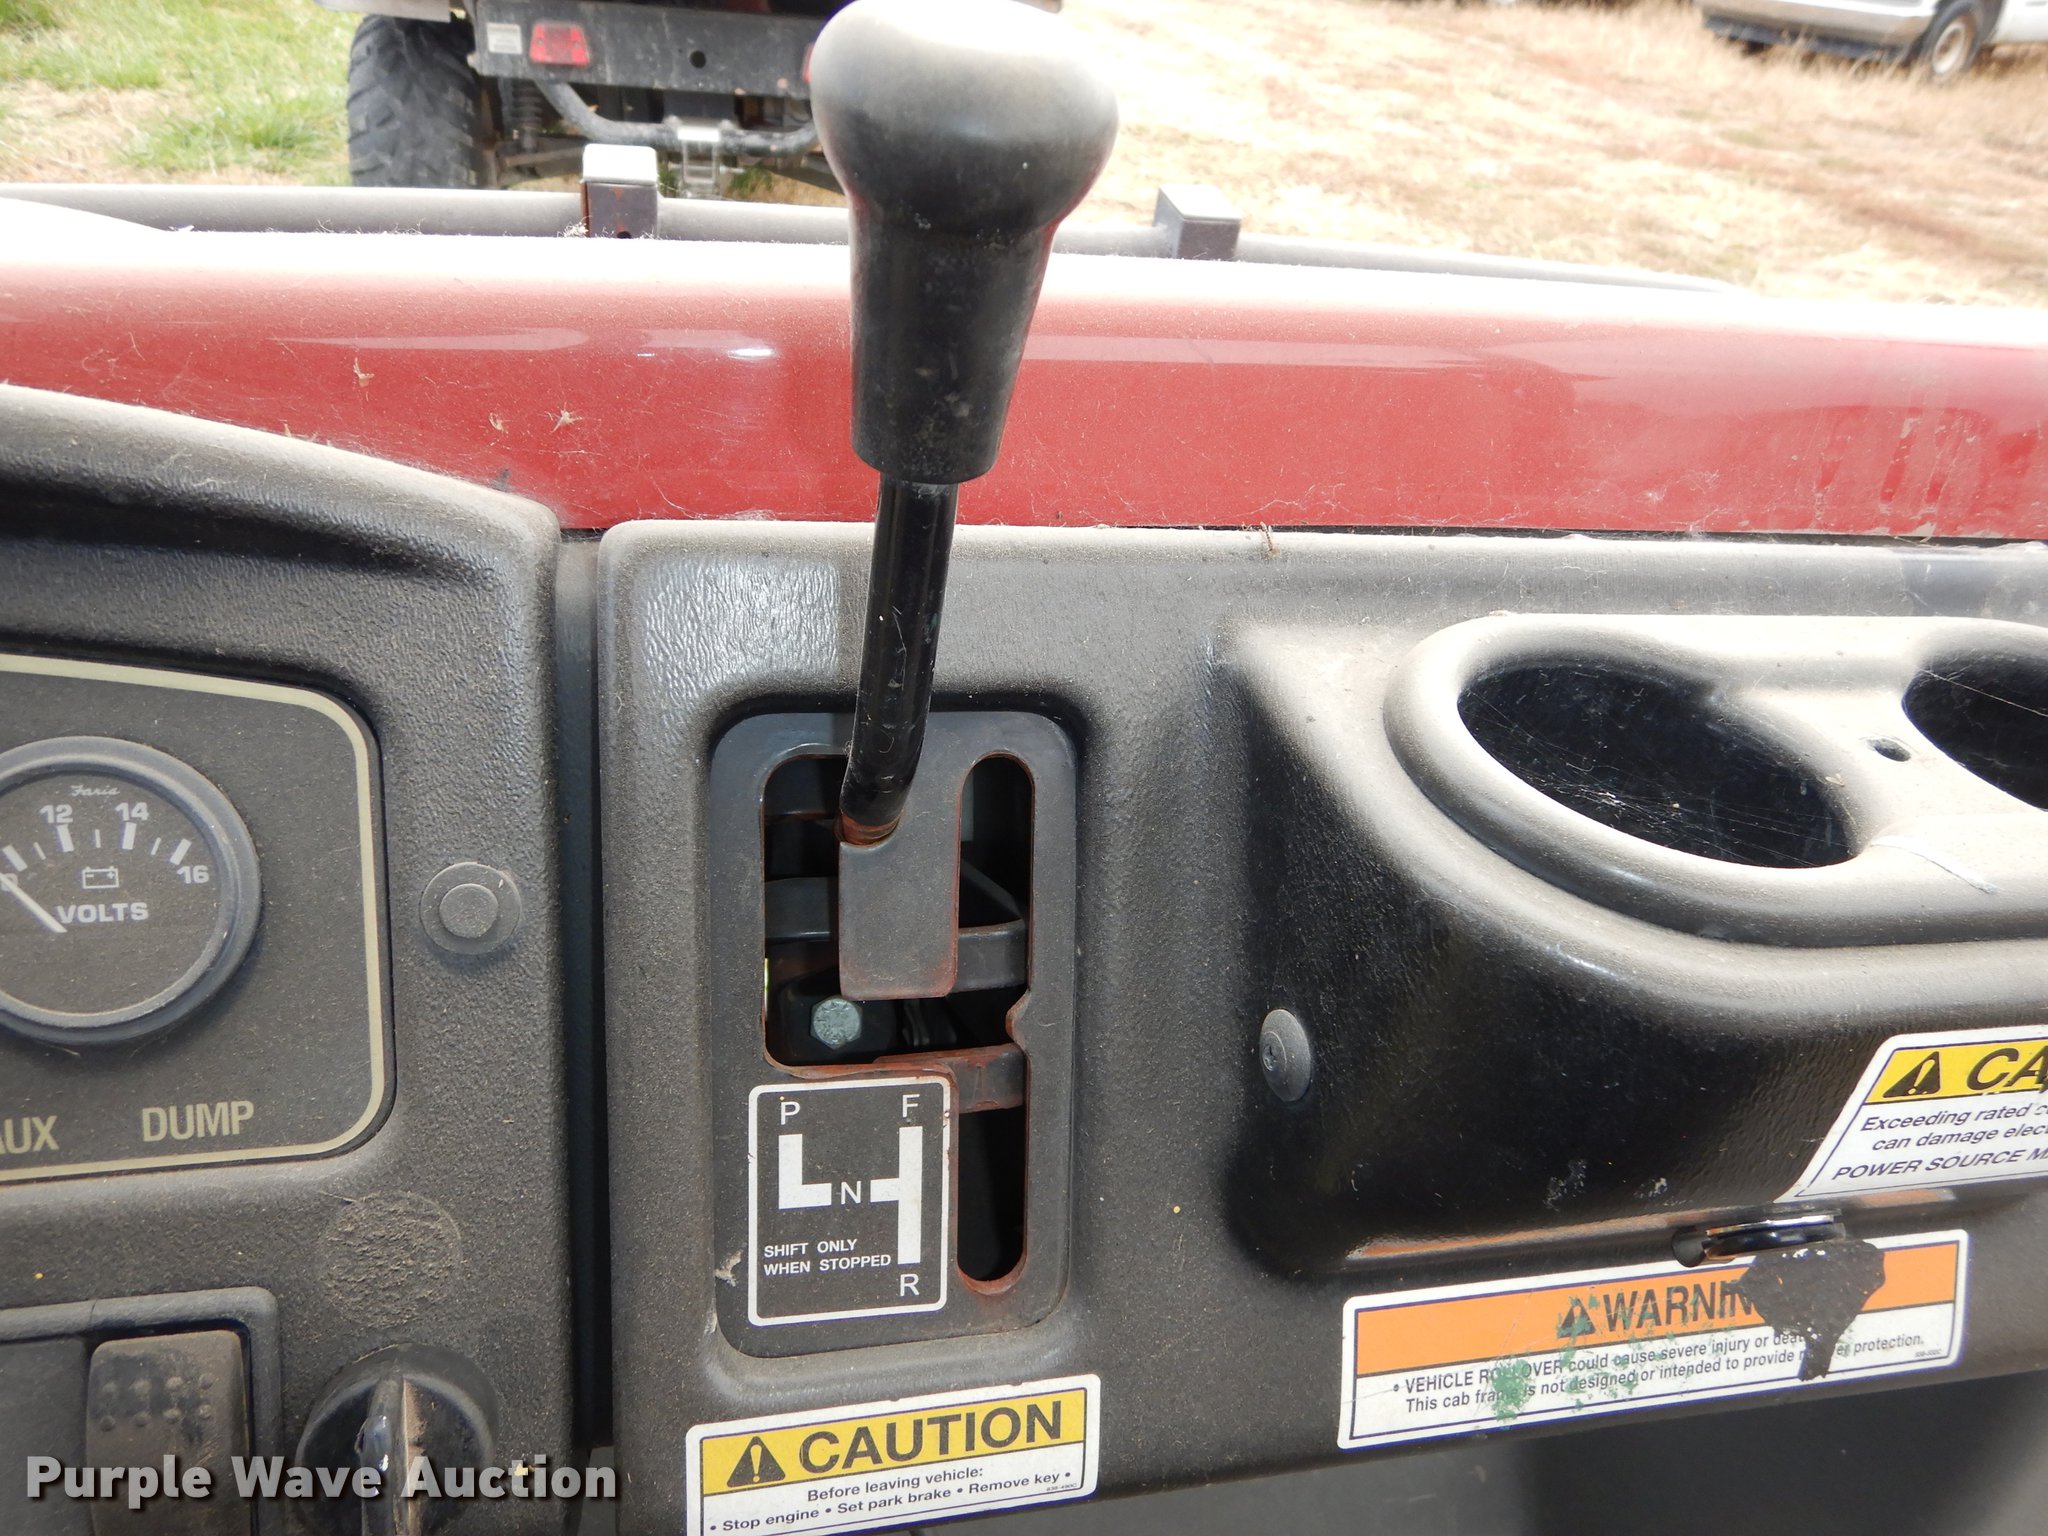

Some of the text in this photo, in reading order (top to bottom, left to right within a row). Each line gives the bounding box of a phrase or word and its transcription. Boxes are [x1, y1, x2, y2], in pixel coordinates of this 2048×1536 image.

[40, 804, 74, 824] 12
[115, 802, 149, 822] 14
[177, 865, 210, 884] 16
[56, 902, 149, 924] VOLTS
[780, 1101, 801, 1125] P
[902, 1094, 920, 1117] F
[1860, 1110, 1971, 1131] Exceeding
[1975, 1103, 2033, 1121] rated
[141, 1101, 254, 1142] DUMP
[0, 1115, 60, 1154] UX
[1872, 1137, 1911, 1151] can
[1916, 1129, 1999, 1148] damage
[1832, 1159, 1923, 1180] POWER
[1925, 1149, 2026, 1171] SOURCE
[840, 1181, 862, 1205] N
[764, 1239, 858, 1258] SHIFT ONLY
[764, 1254, 892, 1276] WHEN STOPPED
[900, 1273, 919, 1297] R
[1603, 1280, 1759, 1332] WARNIN
[1406, 1370, 1473, 1393] VEHICLE
[1480, 1359, 1563, 1384] ROOVER
[1568, 1353, 1608, 1372] could
[1614, 1350, 1655, 1366] cause
[1661, 1342, 1707, 1359] severe
[1711, 1337, 1749, 1357] injury
[1755, 1335, 1769, 1348] or
[1406, 1395, 1438, 1413] This
[1443, 1391, 1470, 1407] cab
[1523, 1383, 1537, 1398] is
[1541, 1378, 1565, 1394] not
[1569, 1367, 1640, 1392] designed
[1641, 1369, 1655, 1382] or
[1660, 1356, 1721, 1379] intended
[1725, 1357, 1739, 1371] to
[1744, 1350, 1794, 1373] provide
[1853, 1333, 1924, 1354] protection.
[798, 1400, 1062, 1474] CAUTION
[807, 1467, 983, 1502] Before leaving vehicle:
[722, 1472, 1060, 1531] Stop engine Set park brake Remove key
